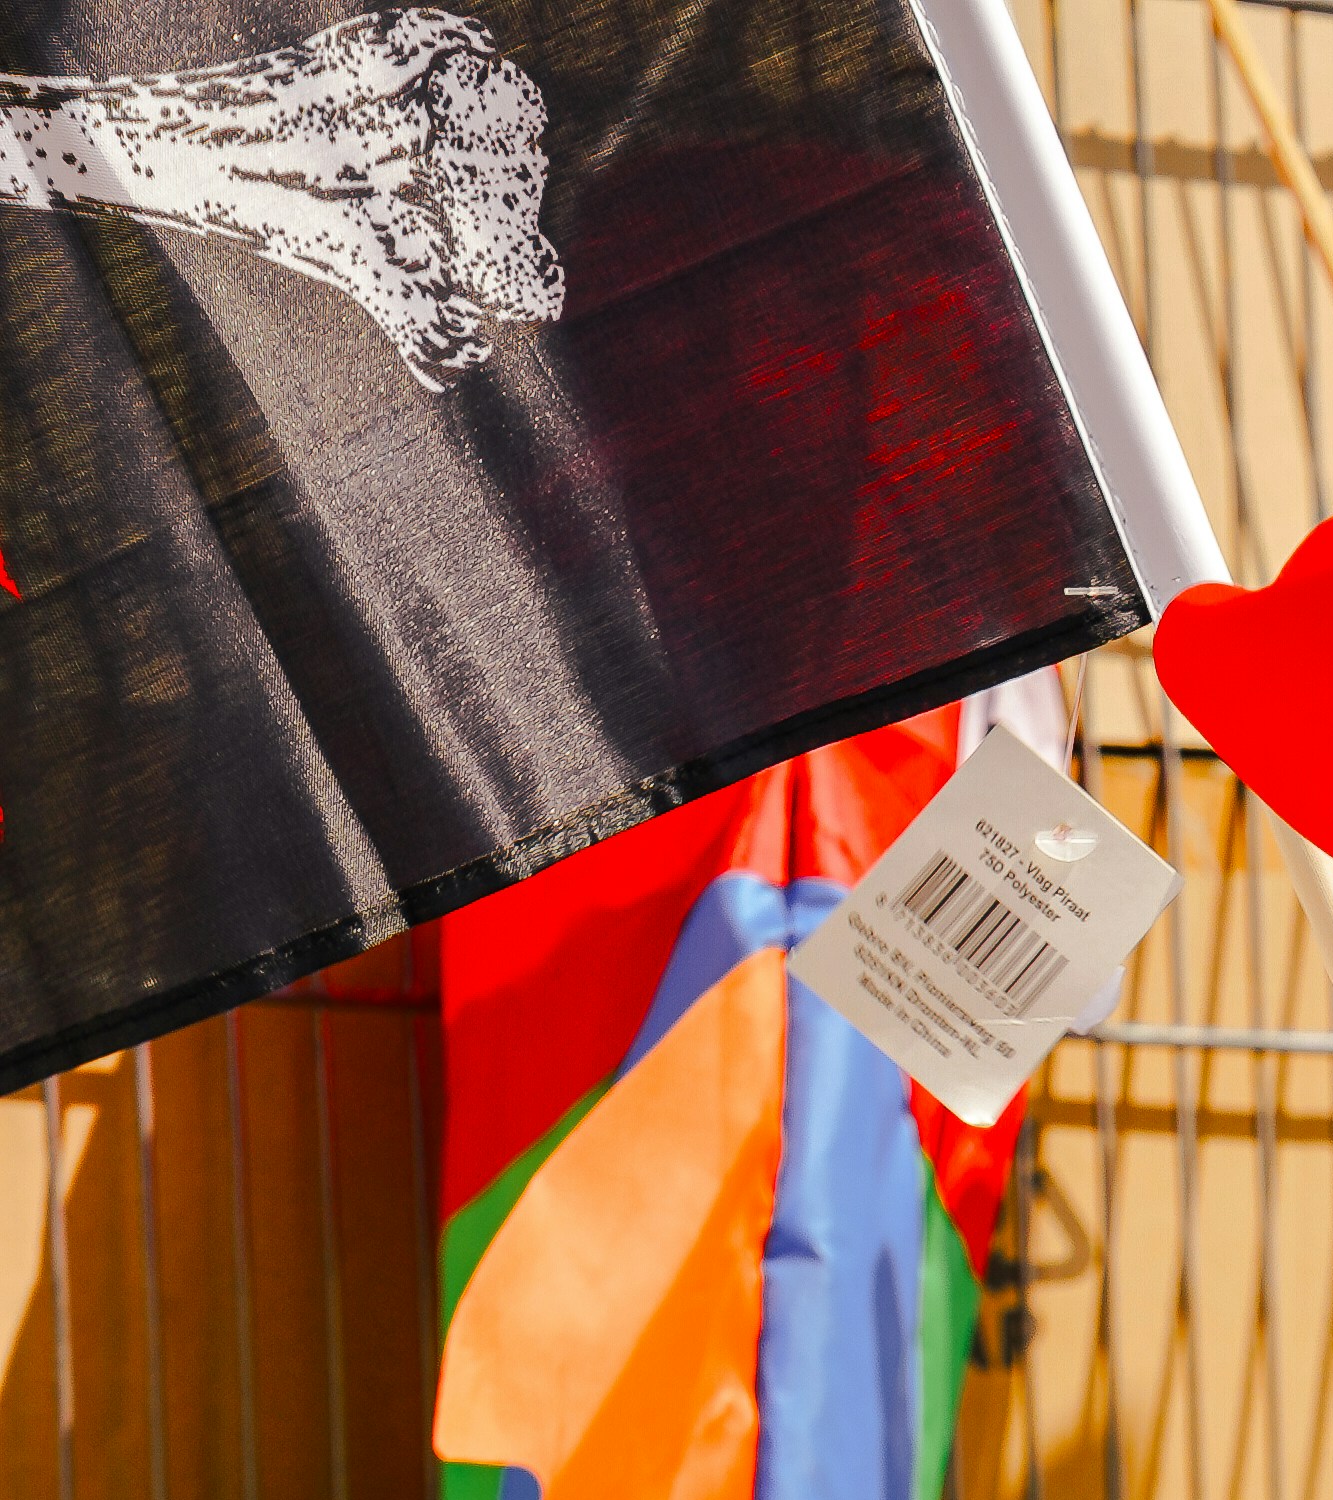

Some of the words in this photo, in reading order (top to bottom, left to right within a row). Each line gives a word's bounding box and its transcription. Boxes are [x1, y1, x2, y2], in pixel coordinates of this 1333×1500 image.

[979, 847, 1003, 874] 75D
[1004, 869, 1061, 922] Polyester
[1027, 862, 1053, 893] Vlag
[1053, 887, 1091, 922] Piraat
